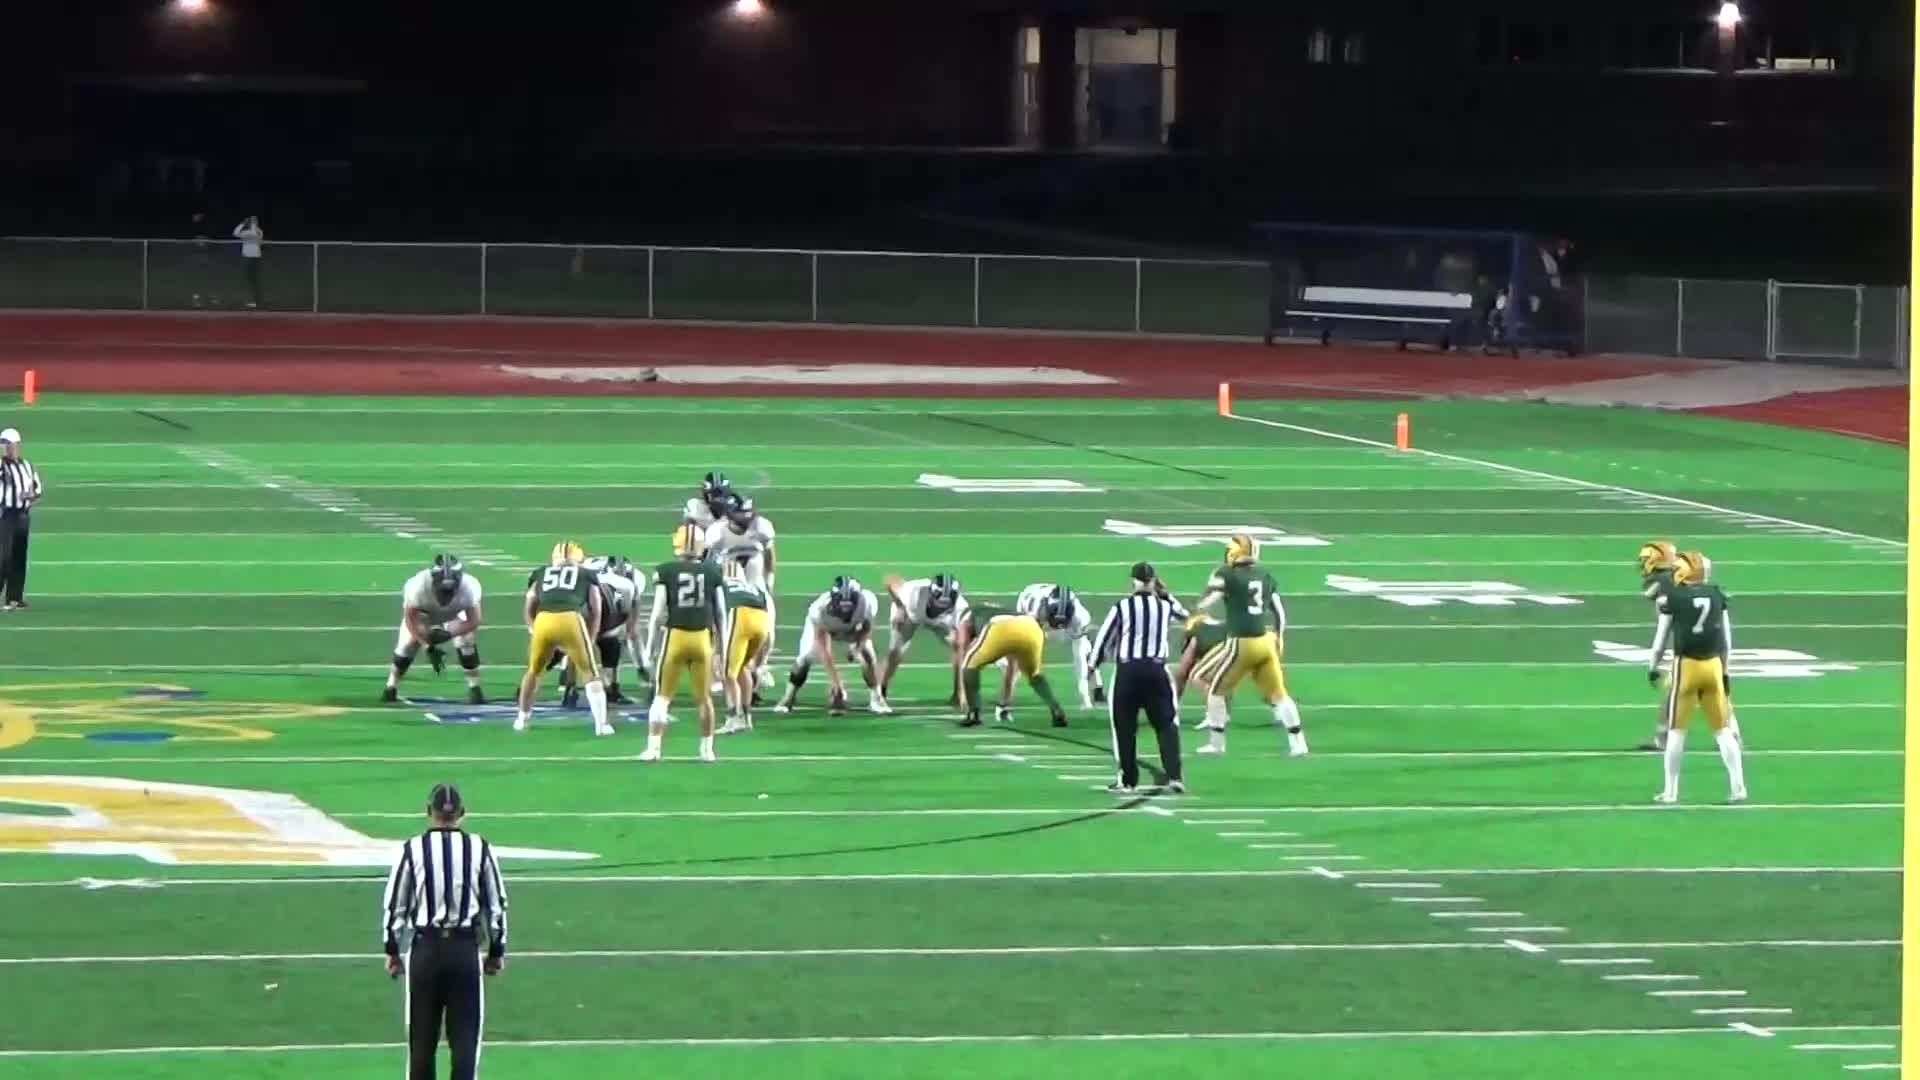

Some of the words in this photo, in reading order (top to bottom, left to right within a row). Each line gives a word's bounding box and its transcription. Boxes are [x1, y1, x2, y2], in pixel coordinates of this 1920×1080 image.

[542, 566, 578, 592] 50
[677, 573, 705, 608] 21
[1247, 580, 1264, 615] 3
[1692, 597, 1711, 634] 7
